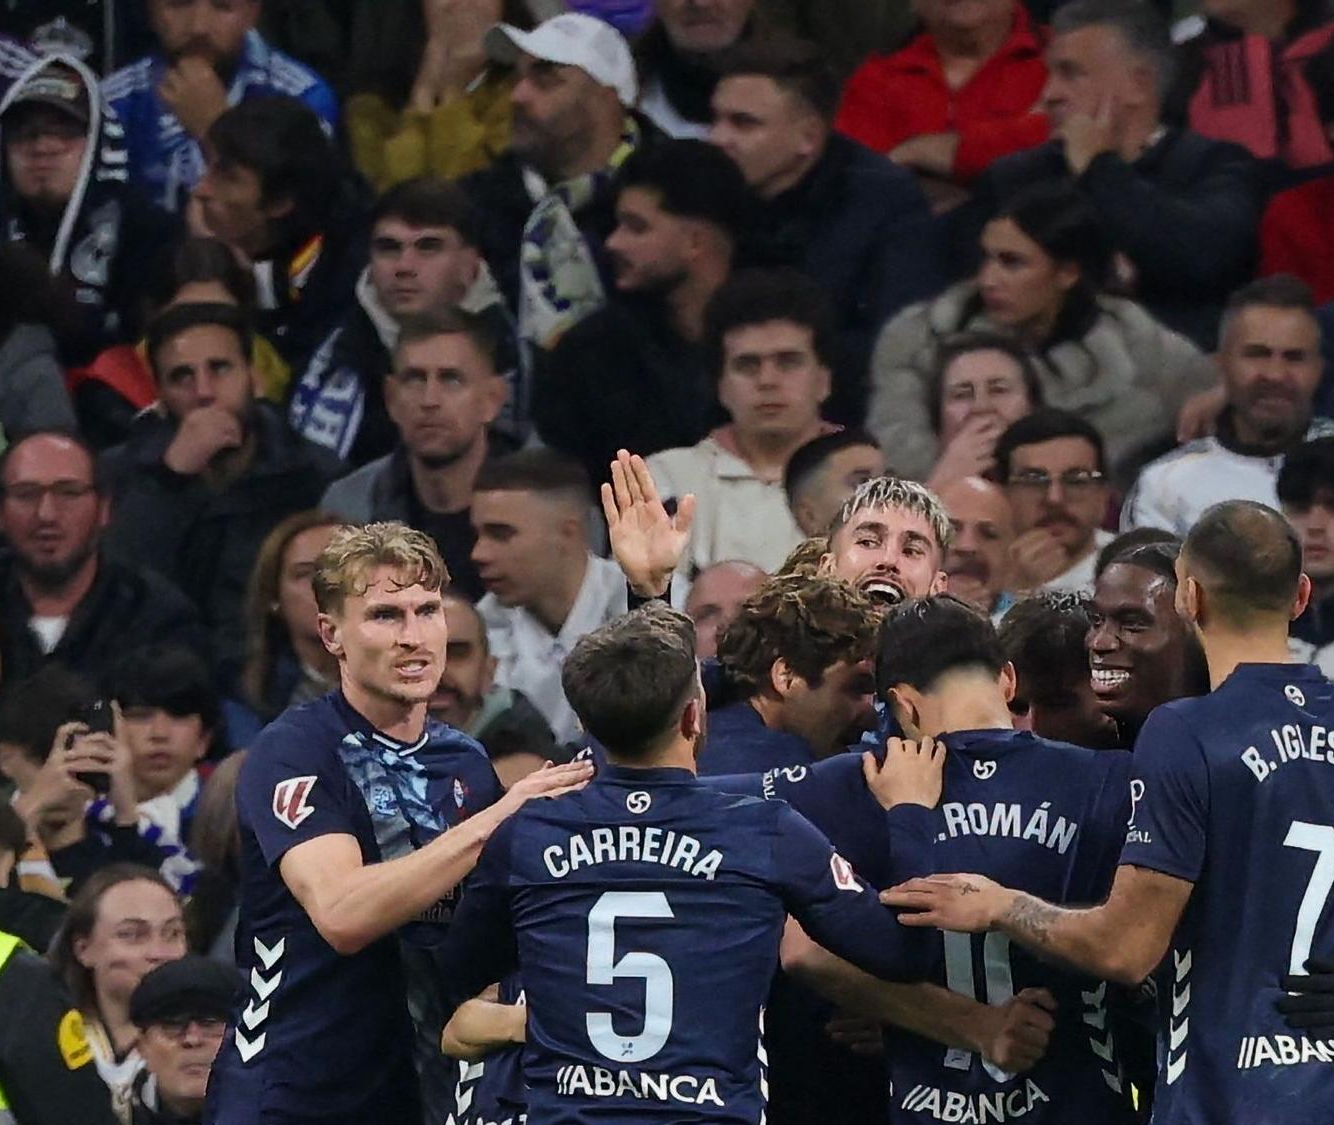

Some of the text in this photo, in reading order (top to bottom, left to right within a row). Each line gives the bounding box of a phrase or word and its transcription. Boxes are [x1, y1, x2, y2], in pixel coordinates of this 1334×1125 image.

[1241, 746, 1278, 782] B.
[543, 826, 723, 880] CARREIRA
[585, 891, 675, 1063] 5
